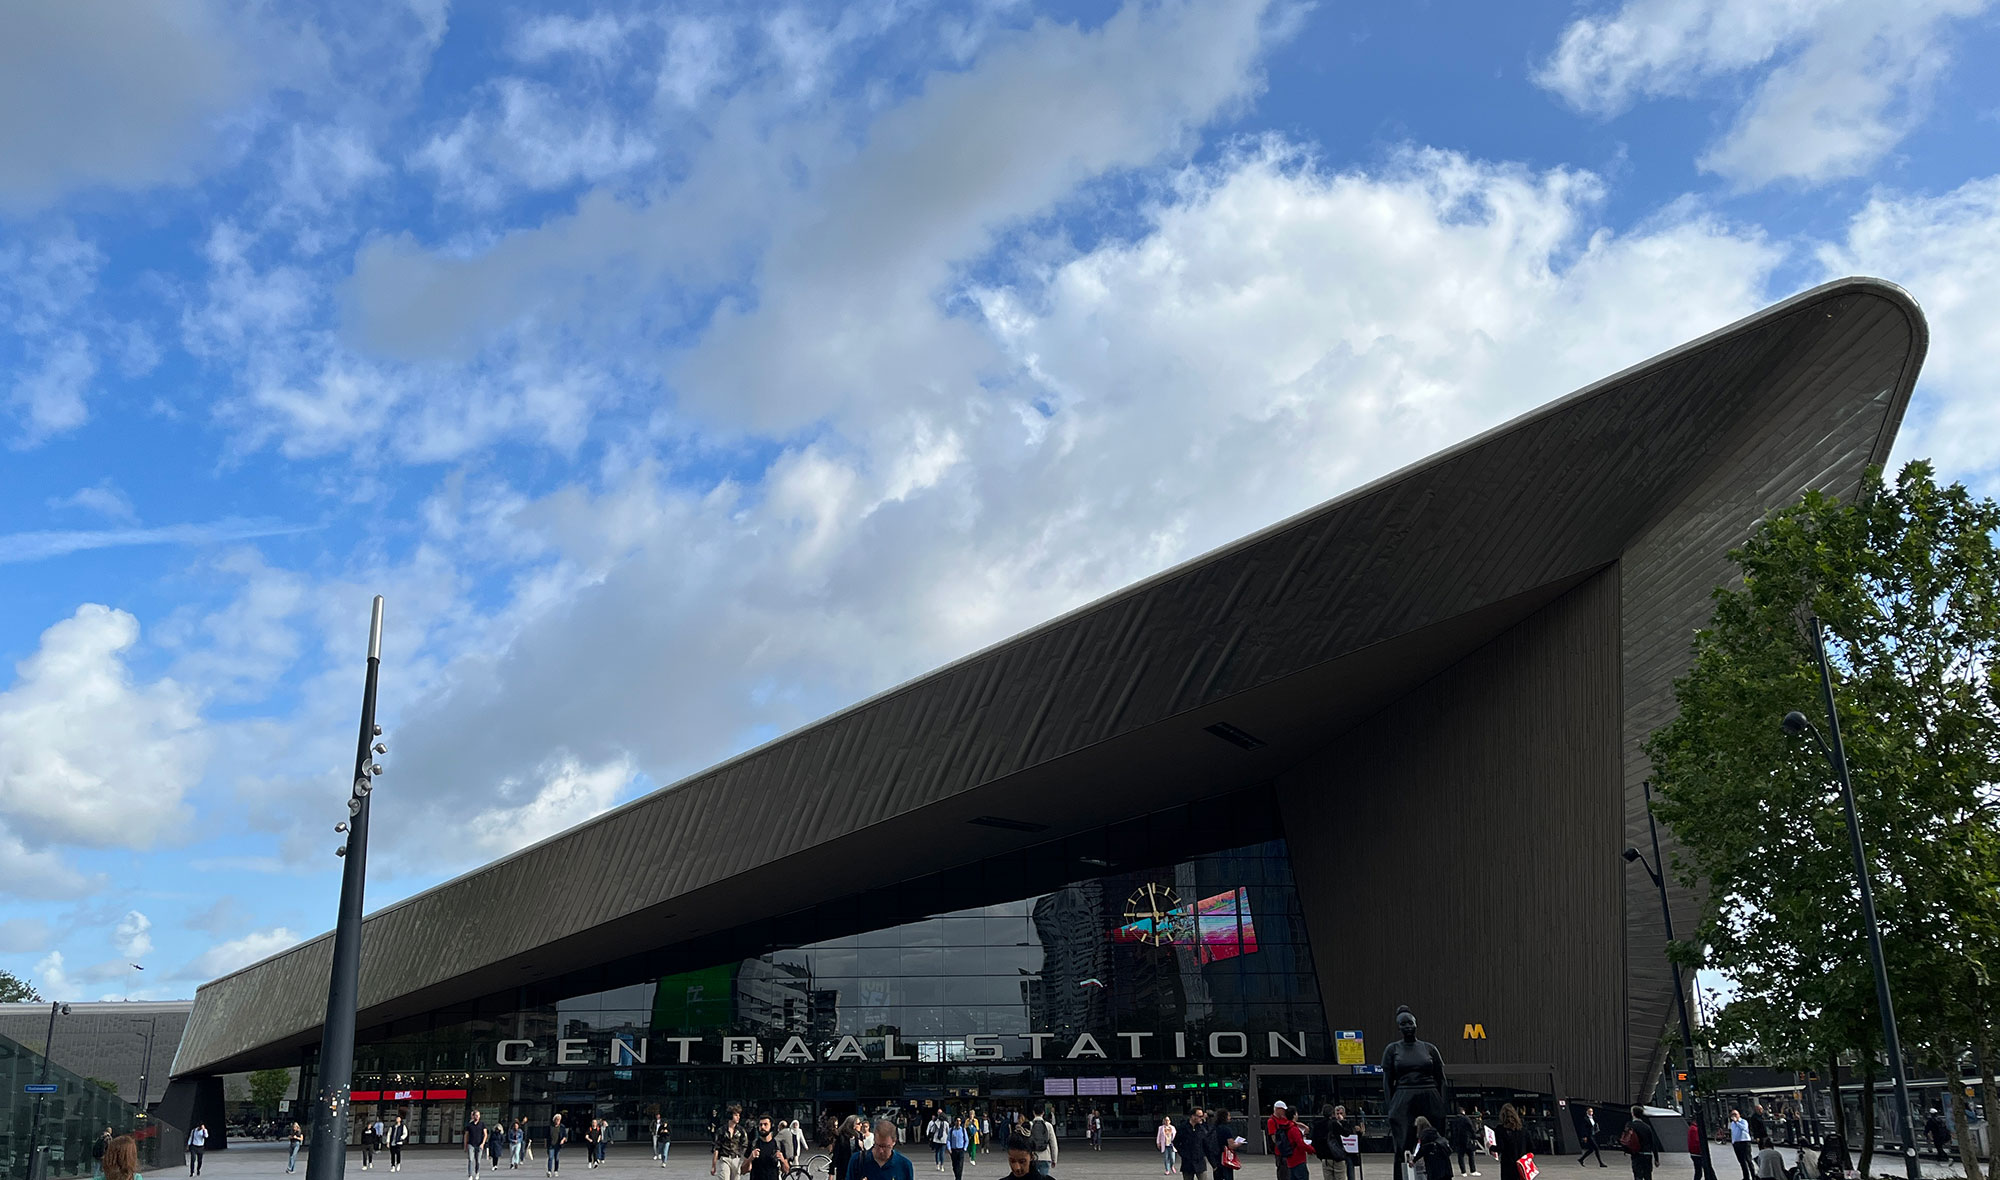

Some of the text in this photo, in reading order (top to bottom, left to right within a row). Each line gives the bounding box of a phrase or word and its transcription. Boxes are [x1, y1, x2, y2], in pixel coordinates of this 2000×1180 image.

[1463, 1023, 1487, 1039] M
[496, 1034, 911, 1065] CENTRAAL
[964, 1031, 1307, 1061] STATION
